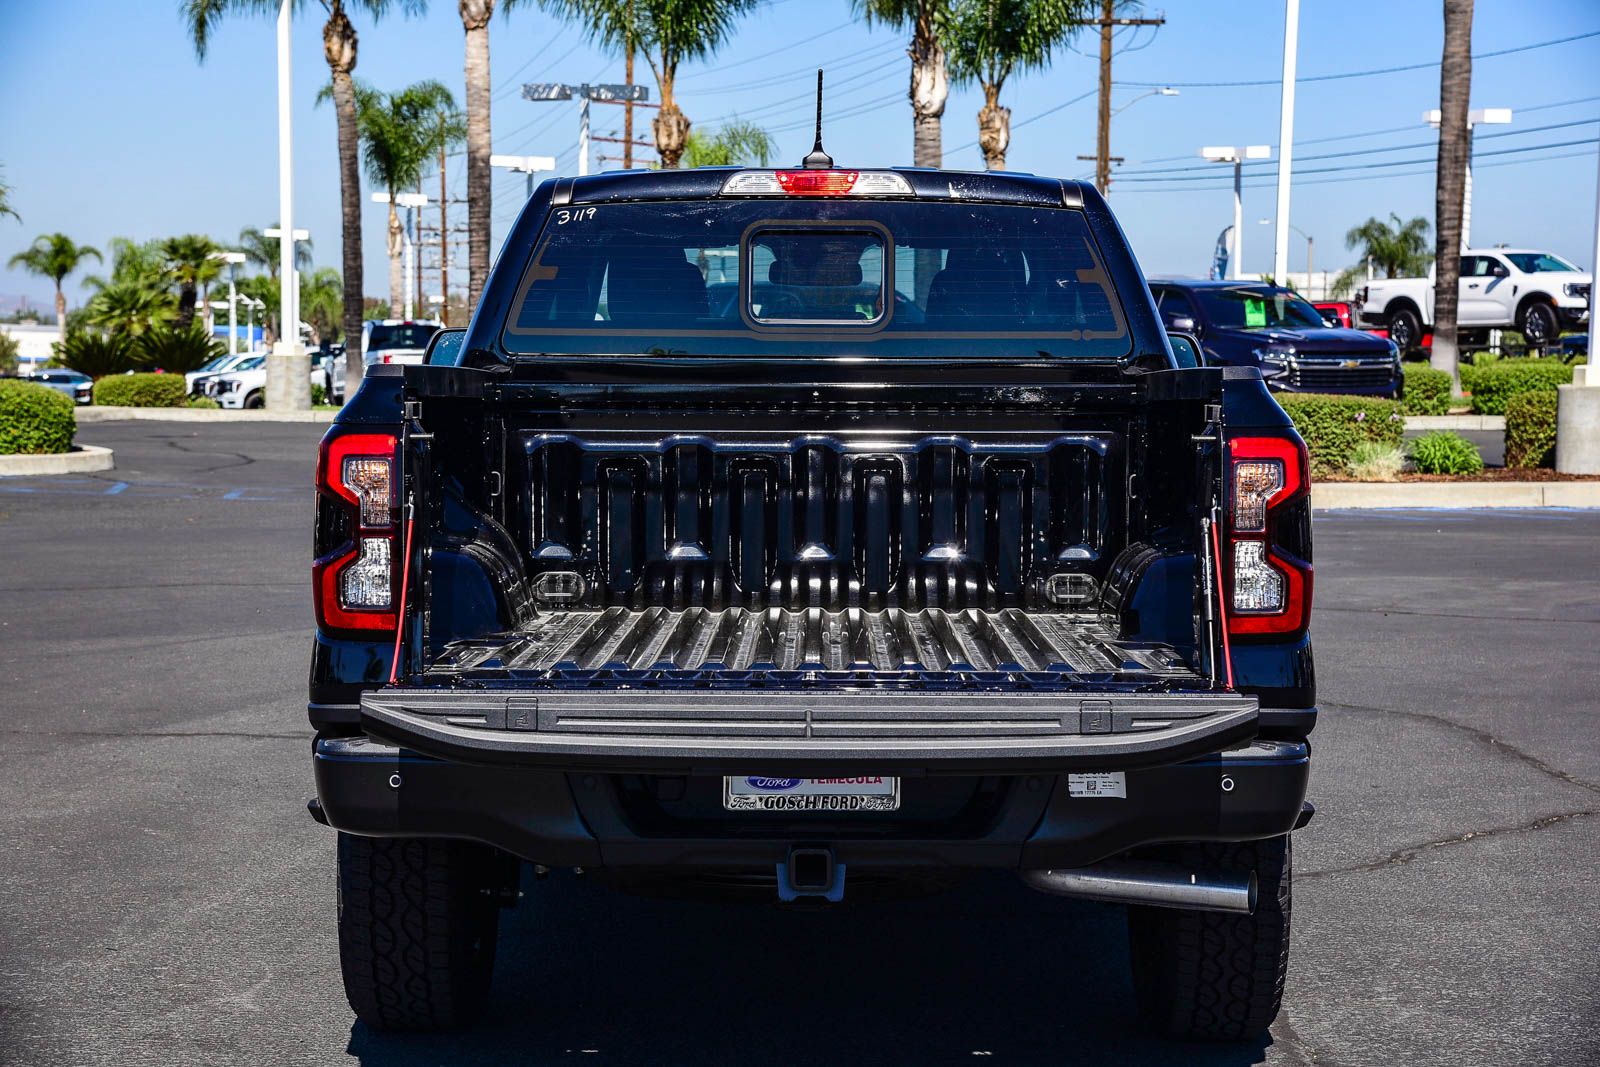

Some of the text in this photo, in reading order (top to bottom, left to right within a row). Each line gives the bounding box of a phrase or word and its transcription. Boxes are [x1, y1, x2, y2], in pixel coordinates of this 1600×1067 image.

[557, 207, 597, 225] 3119
[757, 777, 791, 787] Ford
[810, 776, 883, 785] TEMECULA
[730, 796, 757, 809] Ford
[821, 795, 859, 809] FORD
